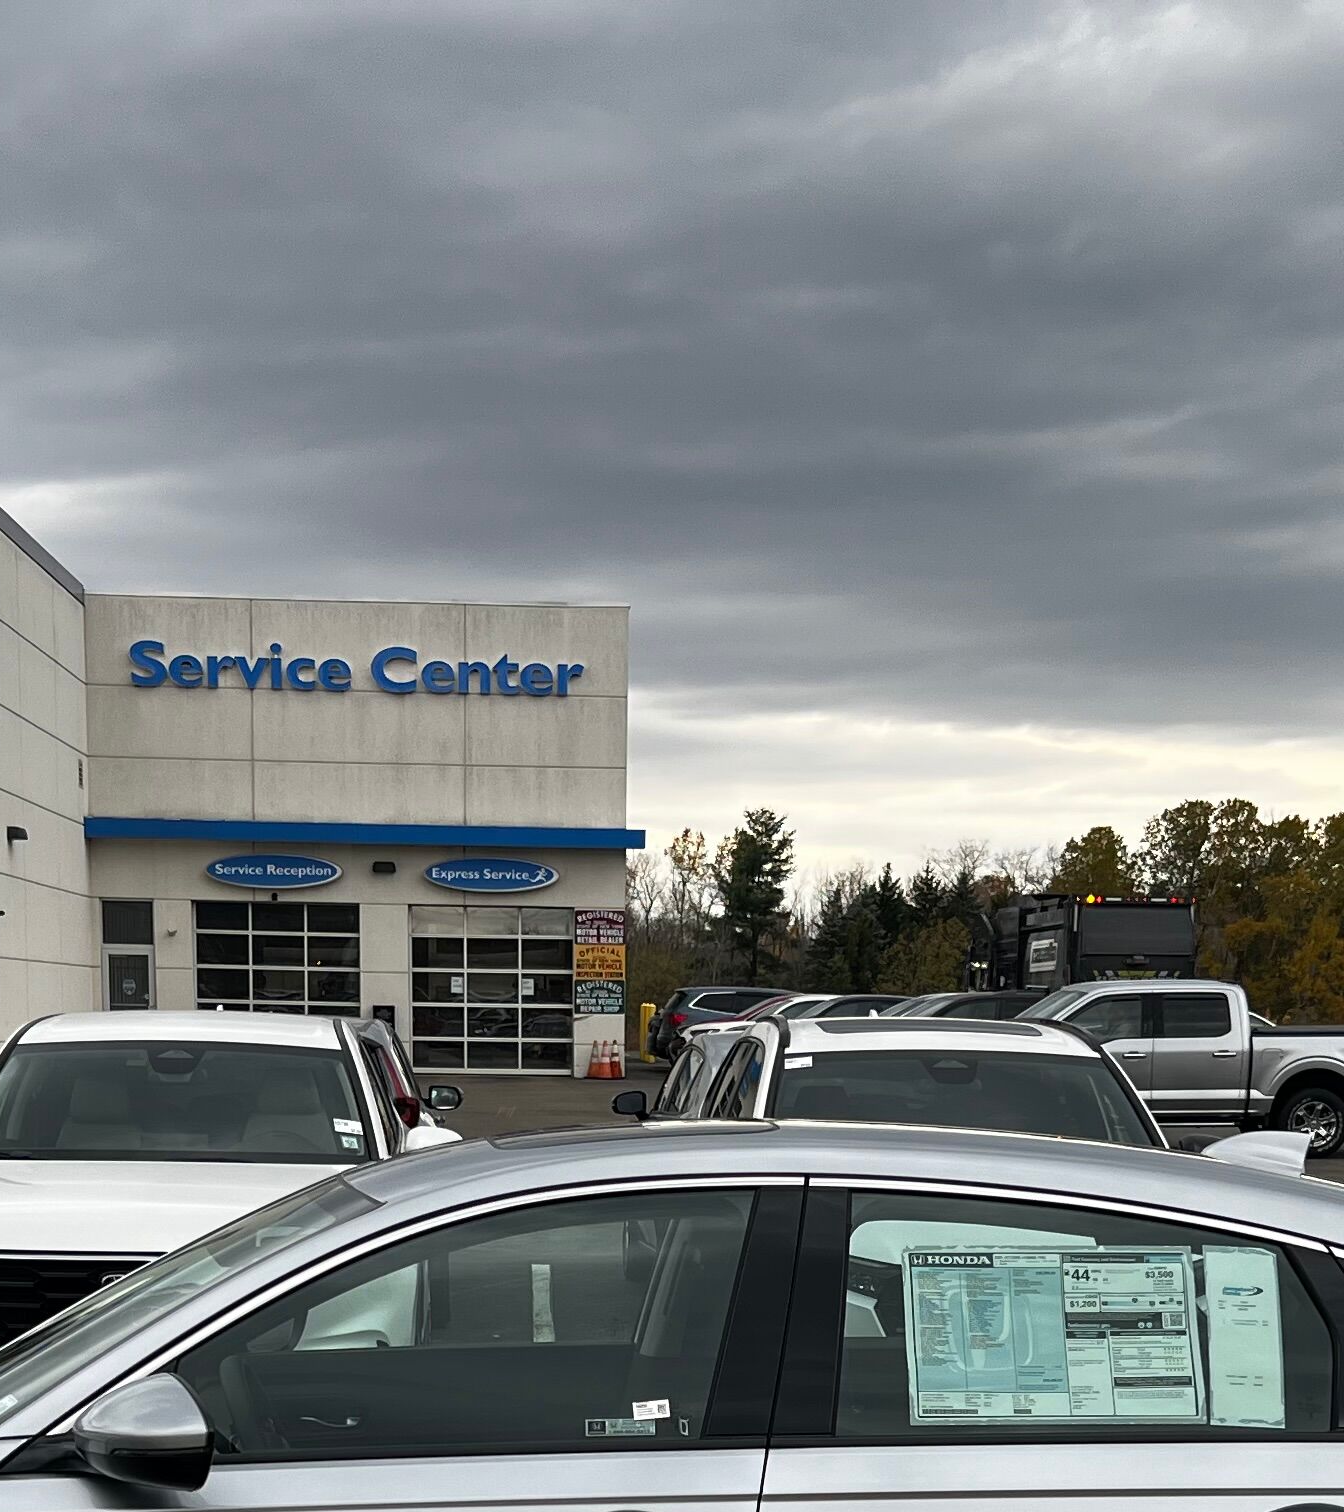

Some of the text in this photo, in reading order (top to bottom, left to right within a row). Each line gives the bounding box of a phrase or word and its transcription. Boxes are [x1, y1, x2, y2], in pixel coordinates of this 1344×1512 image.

[128, 639, 585, 697] Service Center
[214, 863, 333, 879] Service Reception
[431, 867, 530, 881] Express Service
[577, 910, 624, 922] REGISTERED
[579, 946, 621, 957] OFFICIAL
[577, 980, 623, 993] REGISTERED
[926, 1255, 992, 1265] HONDA
[1071, 1269, 1090, 1281] 44
[1145, 1270, 1174, 1279] $3,500
